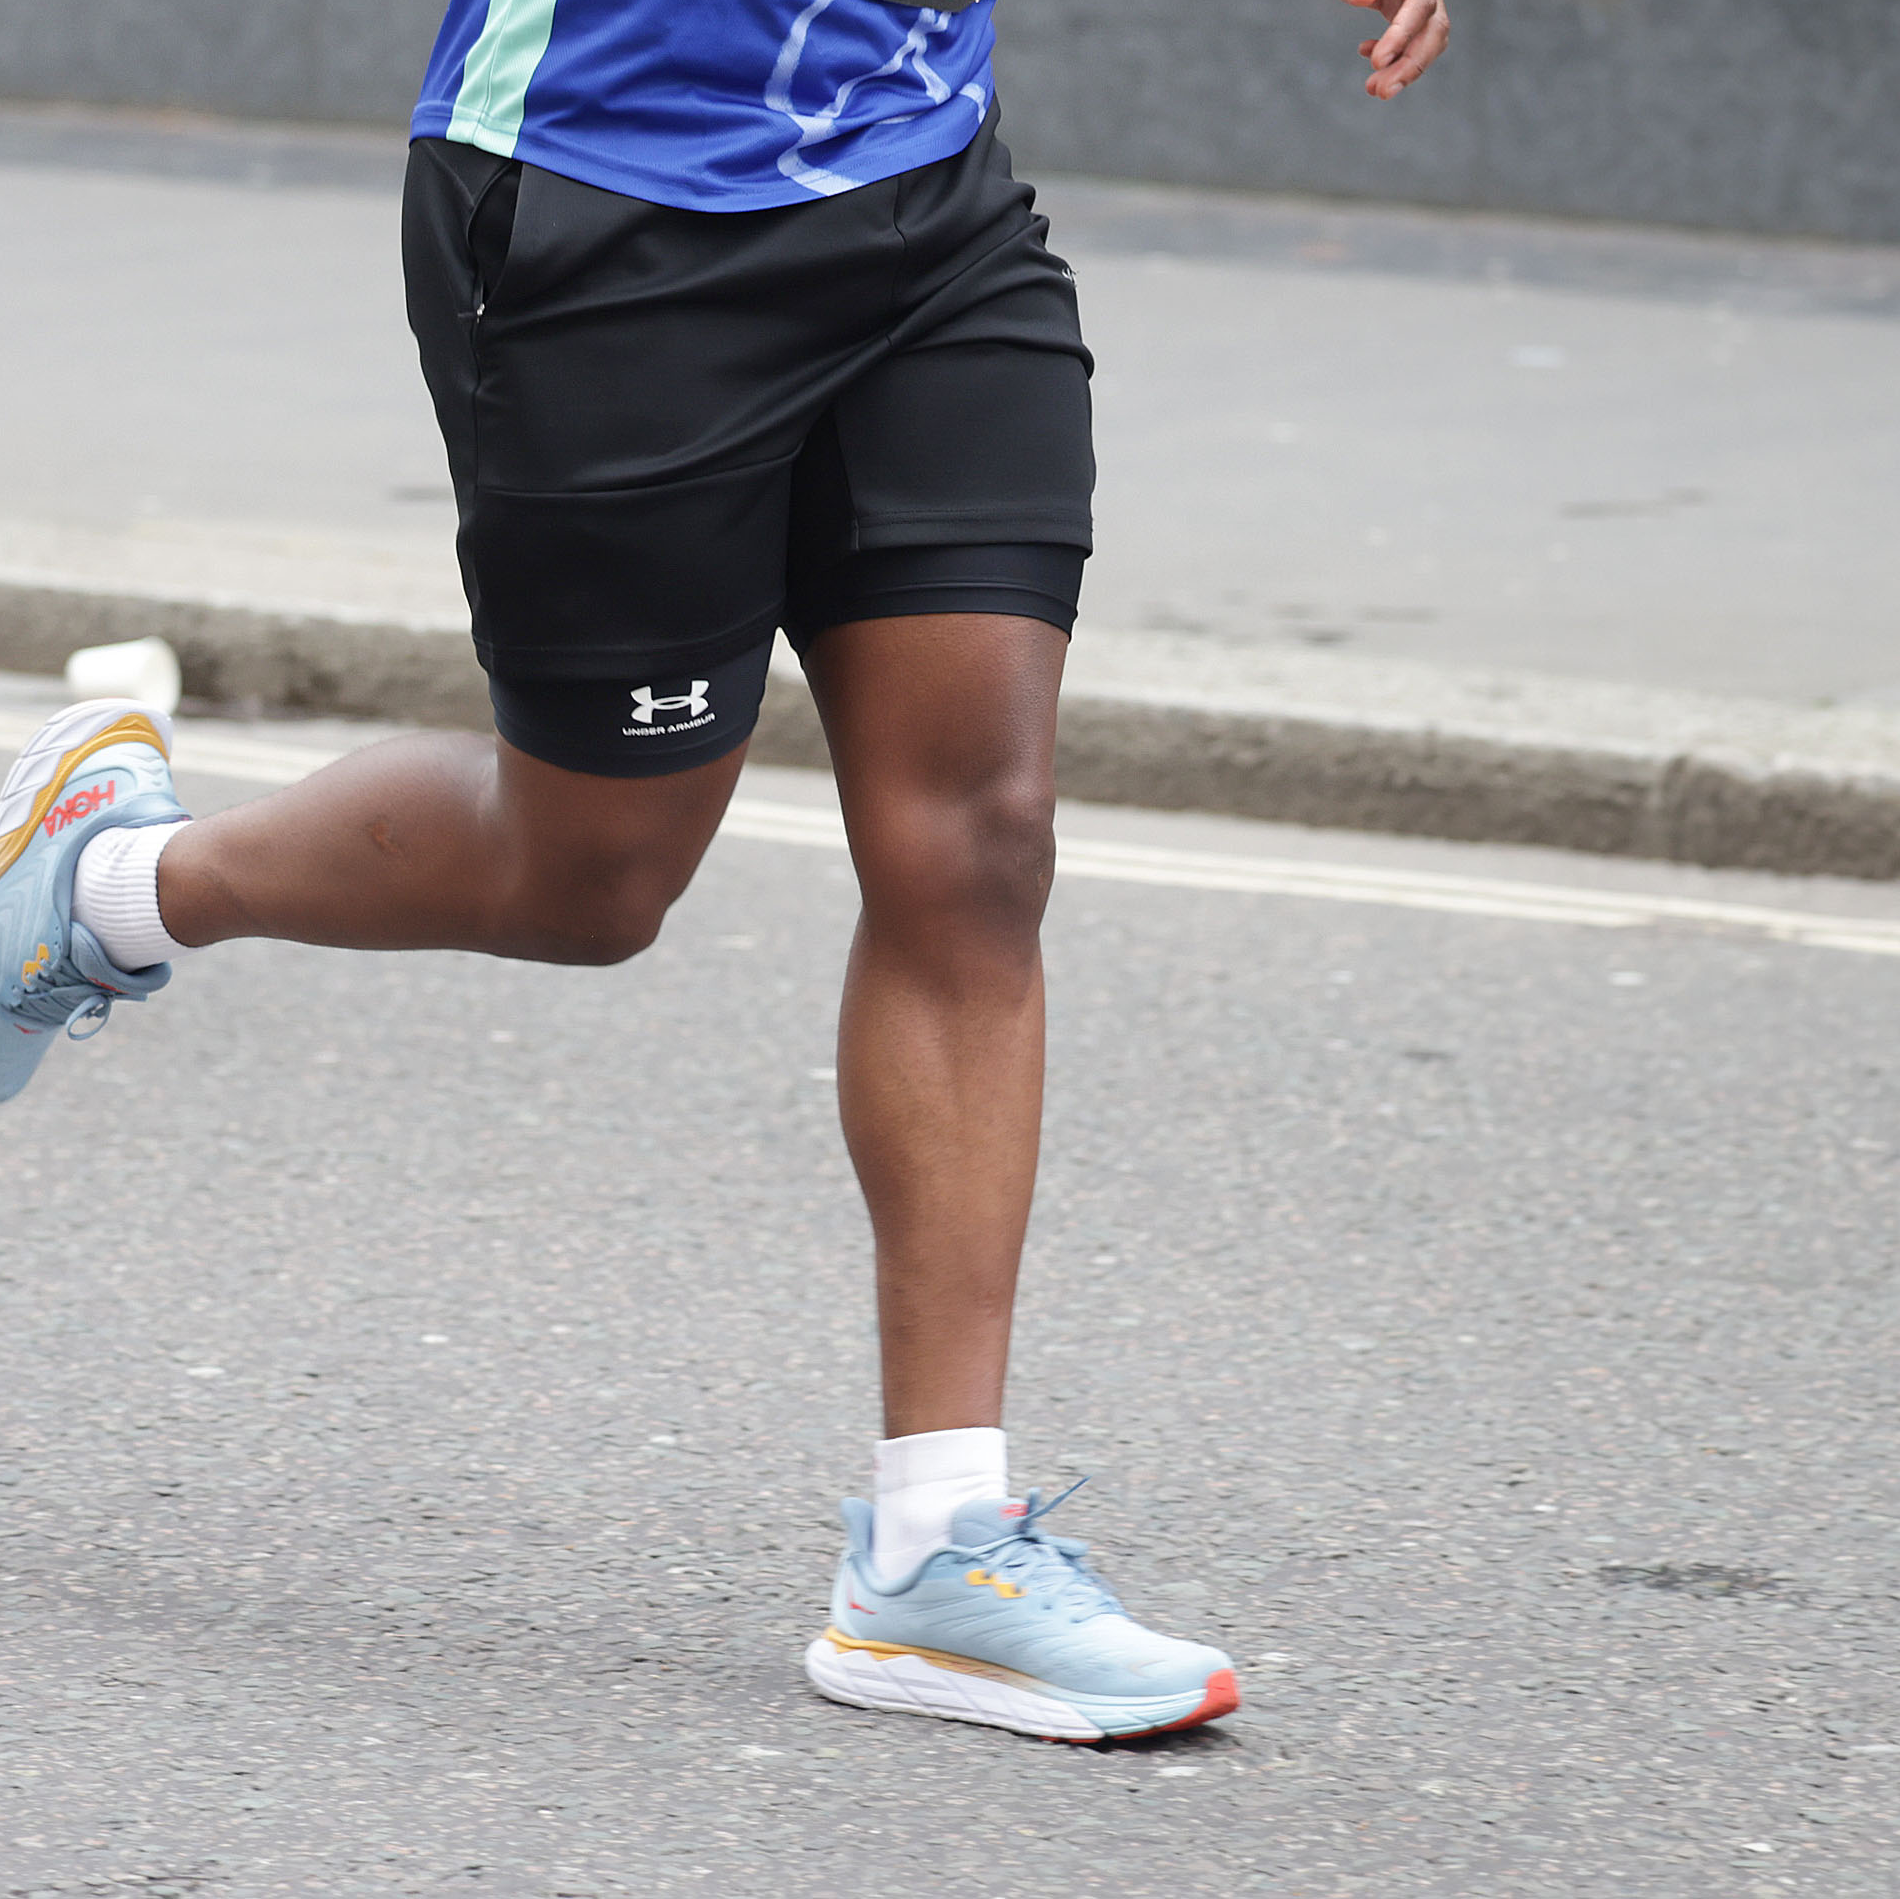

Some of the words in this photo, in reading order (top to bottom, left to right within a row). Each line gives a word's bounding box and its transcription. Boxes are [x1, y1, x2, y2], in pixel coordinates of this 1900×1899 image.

[622, 726, 666, 736] UNDER
[667, 712, 716, 734] ARMOUR
[42, 779, 115, 837] HOKA
